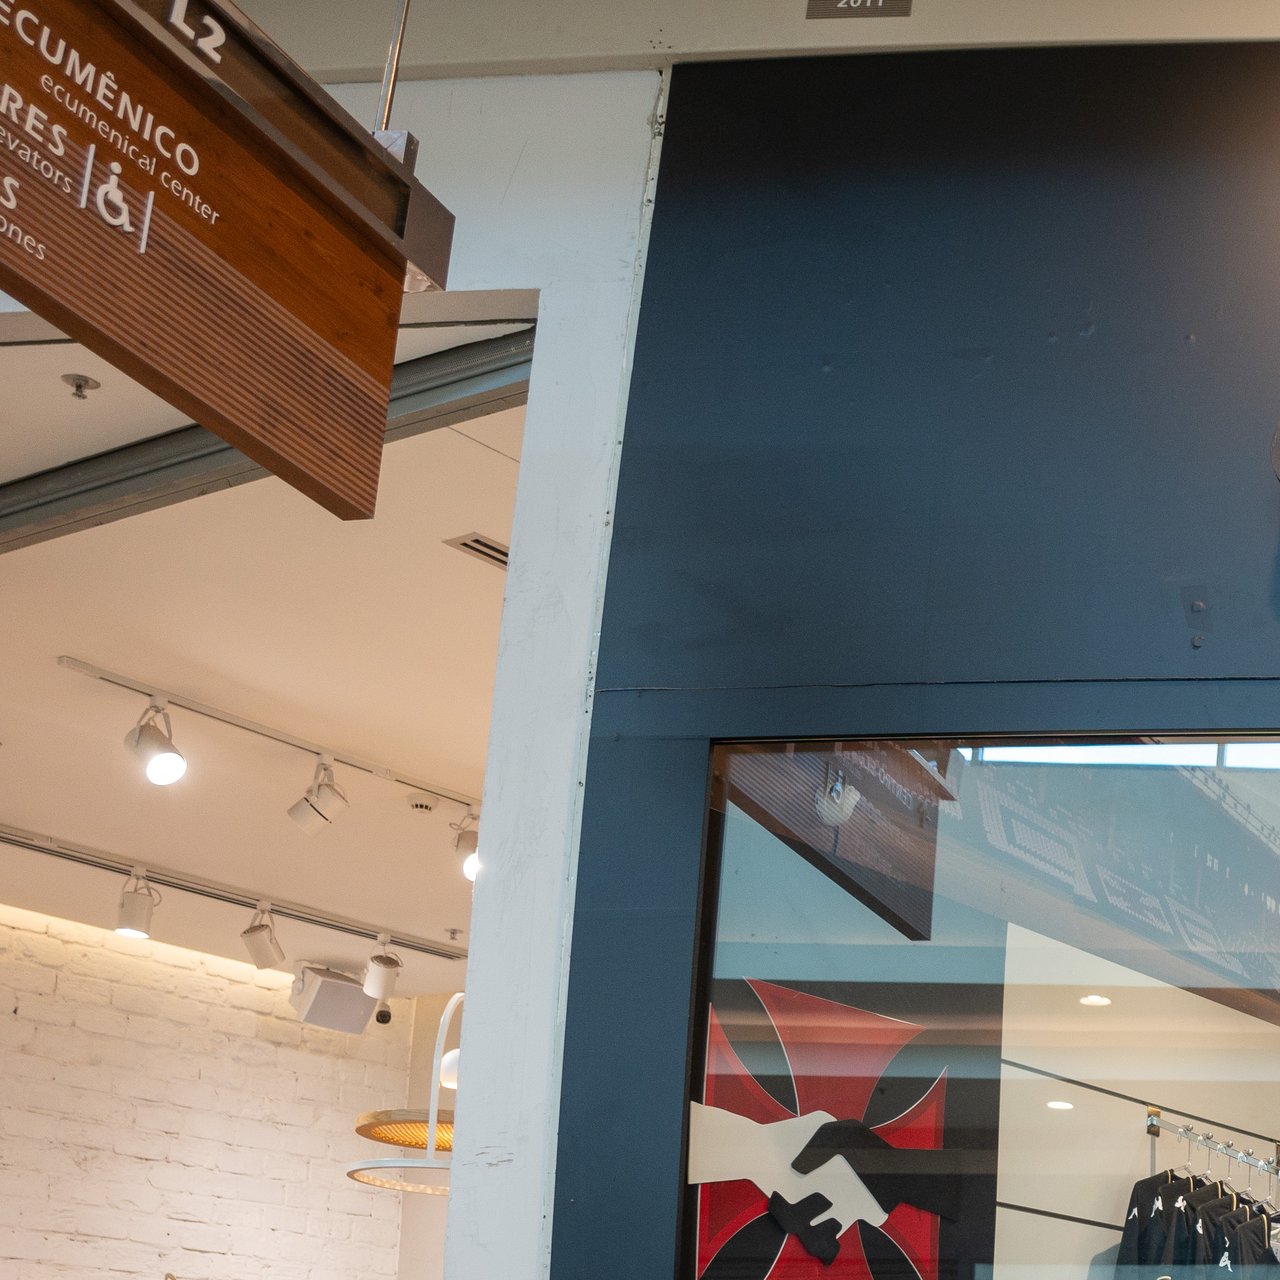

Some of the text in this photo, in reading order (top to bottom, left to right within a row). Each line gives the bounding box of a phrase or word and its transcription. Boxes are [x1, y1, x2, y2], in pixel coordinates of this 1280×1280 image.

[169, 0, 226, 64] L2
[41, 74, 220, 225] ecumenical center
